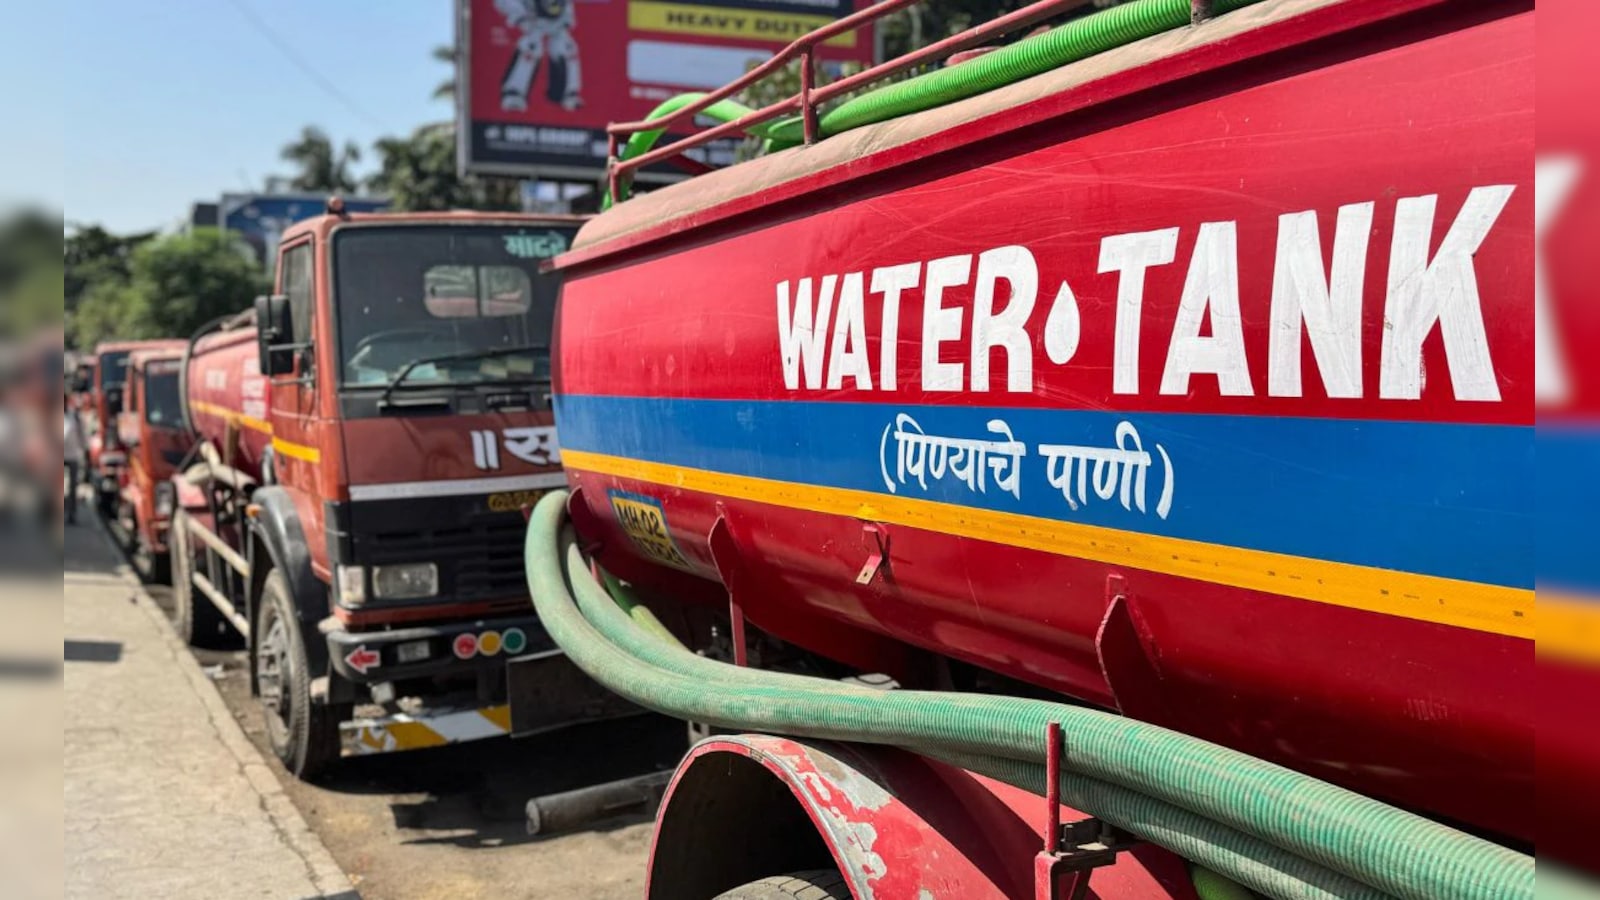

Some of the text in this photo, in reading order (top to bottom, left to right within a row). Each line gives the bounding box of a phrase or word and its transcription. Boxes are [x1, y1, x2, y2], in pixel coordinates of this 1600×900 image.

[667, 12, 746, 29] HEAVY
[776, 184, 1516, 402] WATER TANK
[880, 413, 1175, 520] (पिण्याचे पाणी)
